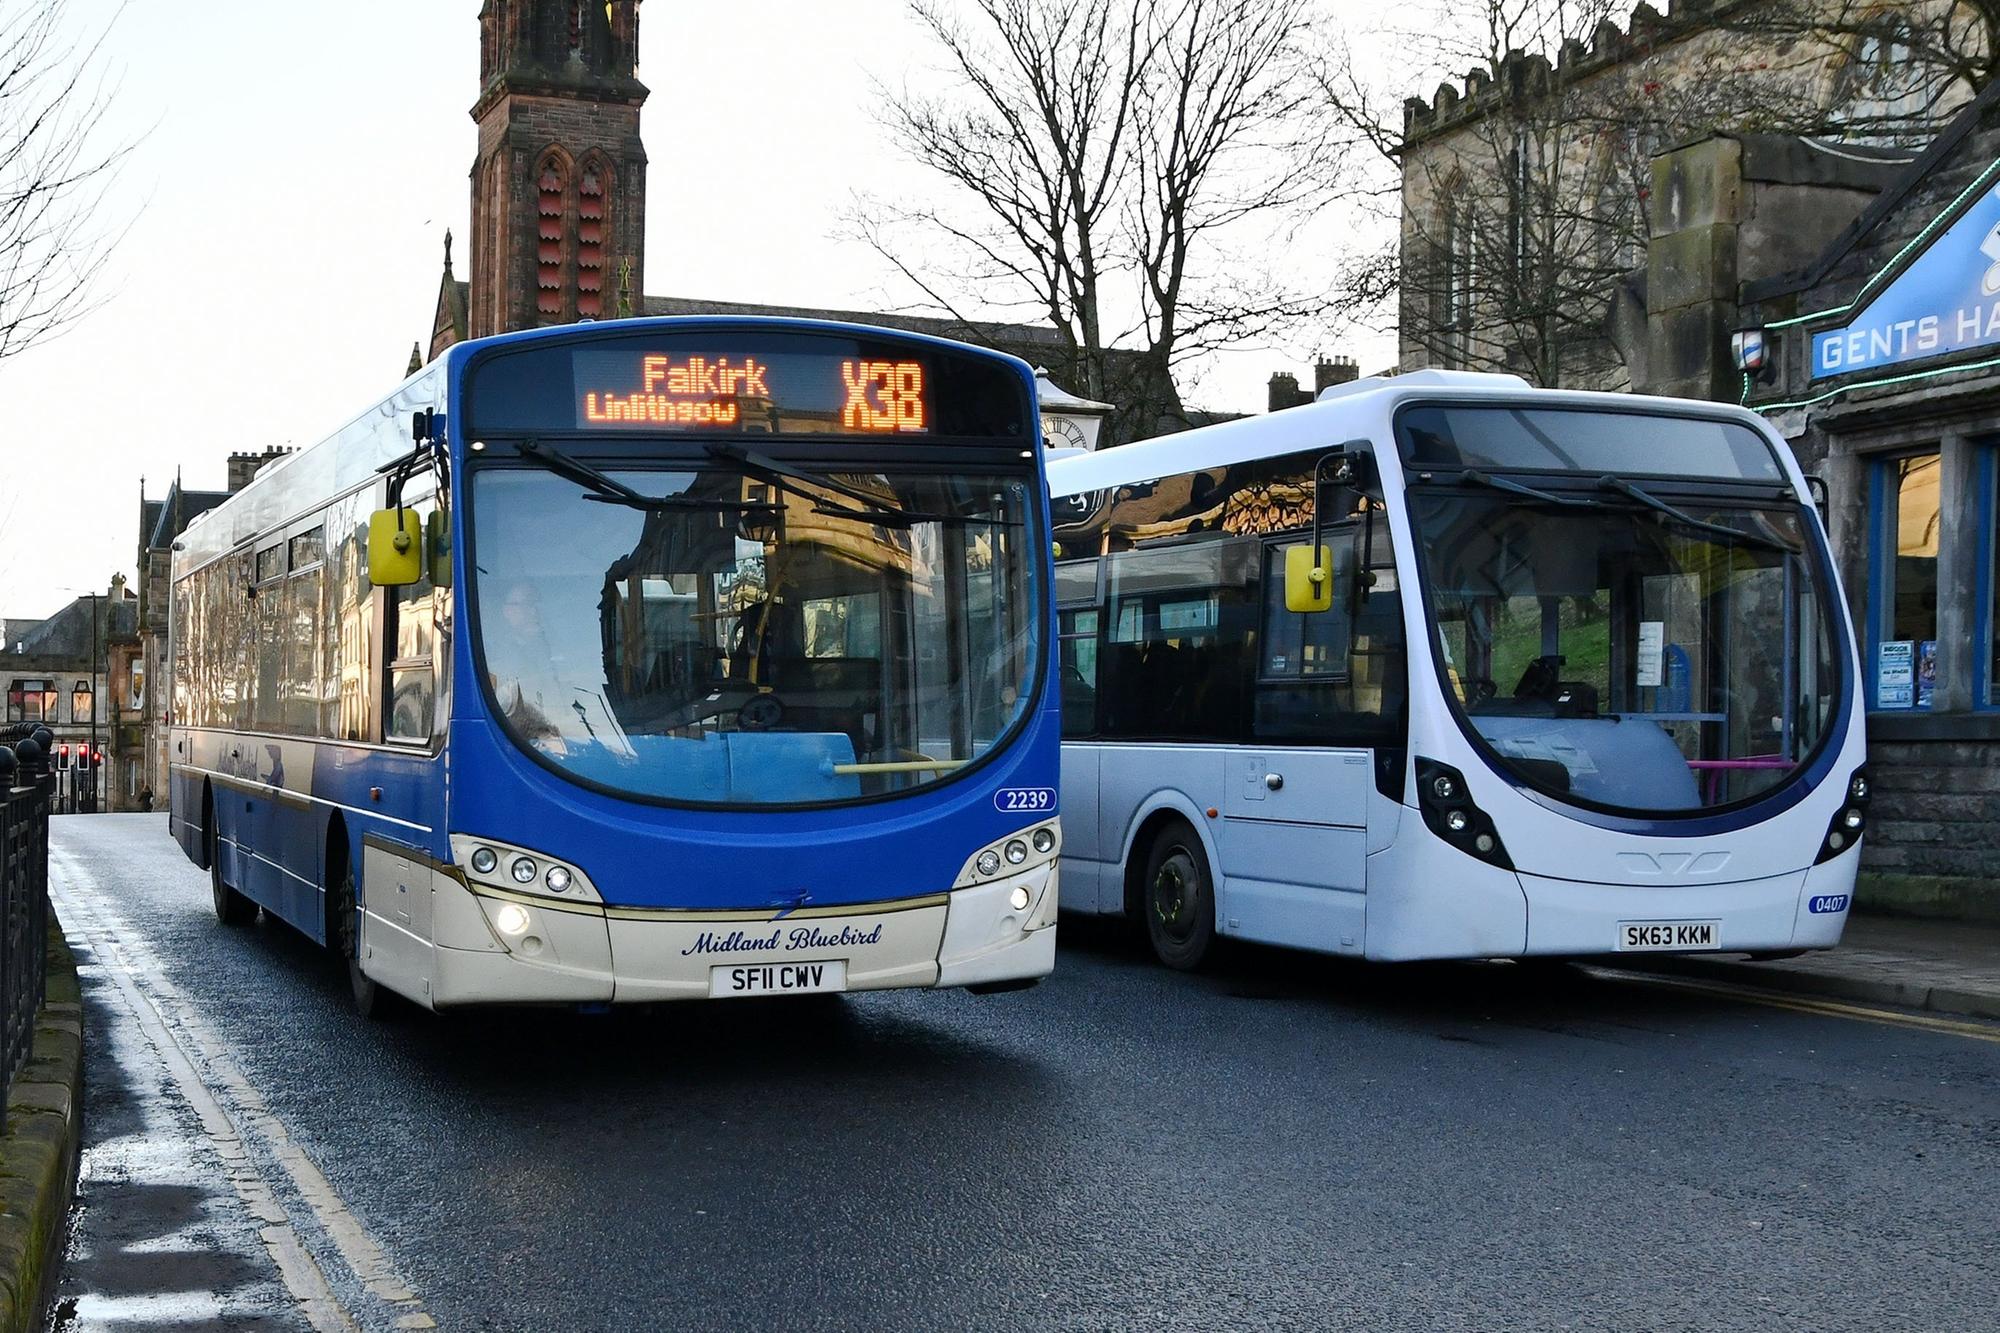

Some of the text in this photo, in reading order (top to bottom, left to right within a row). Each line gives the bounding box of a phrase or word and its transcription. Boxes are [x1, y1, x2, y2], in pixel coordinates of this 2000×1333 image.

[1822, 316, 1938, 369] GENTS
[645, 357, 769, 394] Falkirk
[587, 393, 735, 422] Linlithgow
[842, 362, 923, 428] X38
[1007, 791, 1048, 808] 2239
[1816, 897, 1844, 911] 0407
[682, 924, 882, 955] Midland Bluebird
[1628, 926, 1710, 946] SK63 KKM
[732, 965, 823, 990] SF11 CWV
